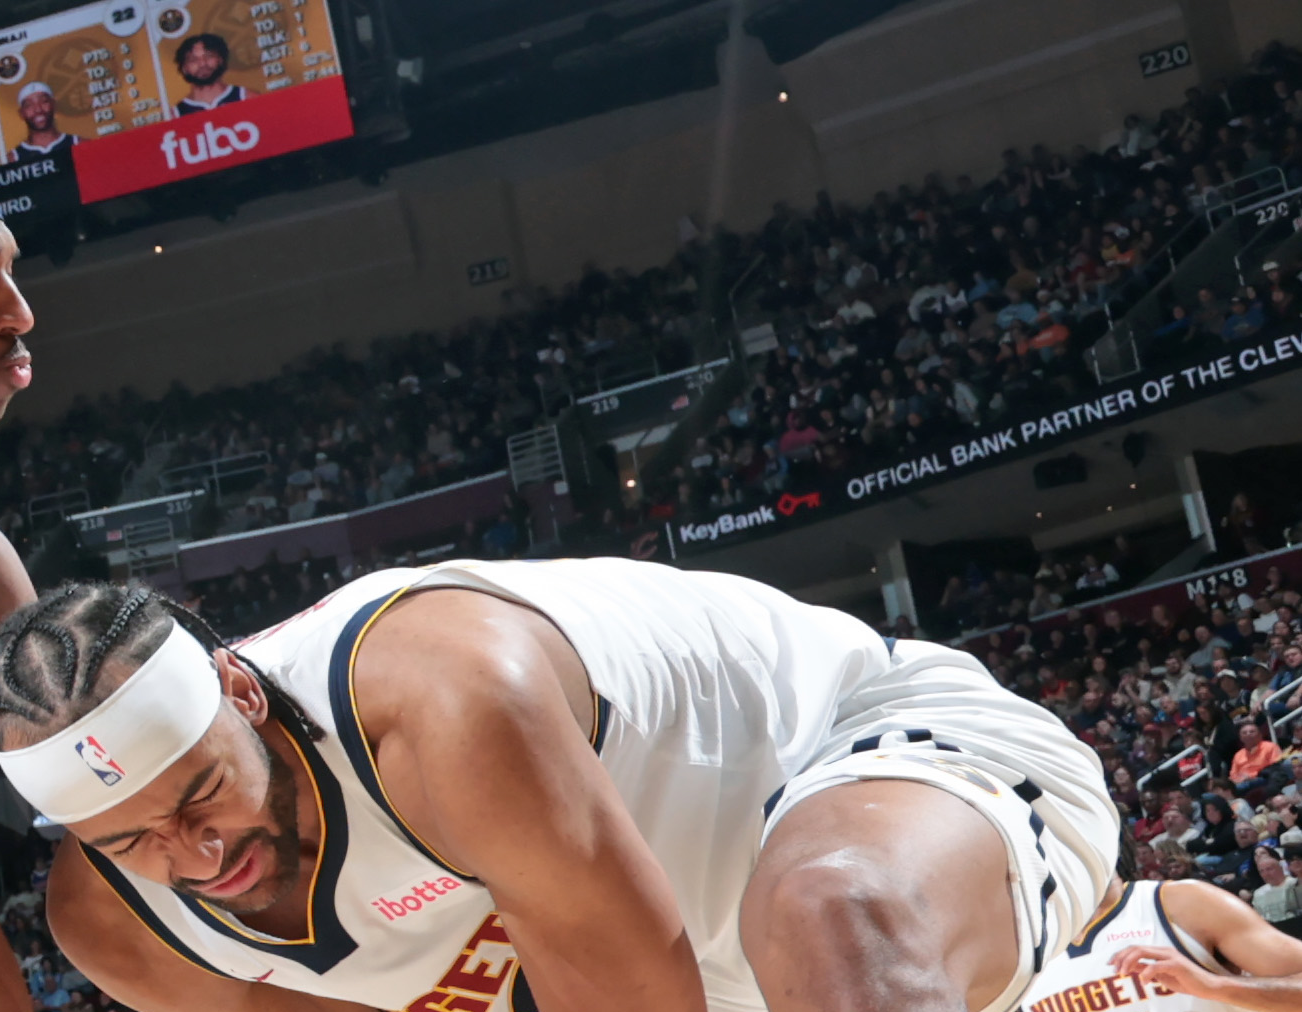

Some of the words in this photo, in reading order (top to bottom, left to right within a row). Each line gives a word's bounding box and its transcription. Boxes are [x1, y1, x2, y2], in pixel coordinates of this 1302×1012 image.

[112, 7, 135, 24] 22
[1142, 46, 1188, 75] 220
[161, 121, 260, 170] fubo
[1255, 201, 1288, 225] 220
[591, 396, 619, 415] 219
[847, 453, 947, 499] OFFICIAL
[950, 428, 1017, 467] BANK
[1020, 389, 1137, 442] PARTNER
[1141, 374, 1175, 404] OF
[1180, 355, 1236, 390] THE
[679, 505, 775, 543] KeyBank
[371, 876, 462, 921] ibotta
[1106, 929, 1152, 943] ibotta
